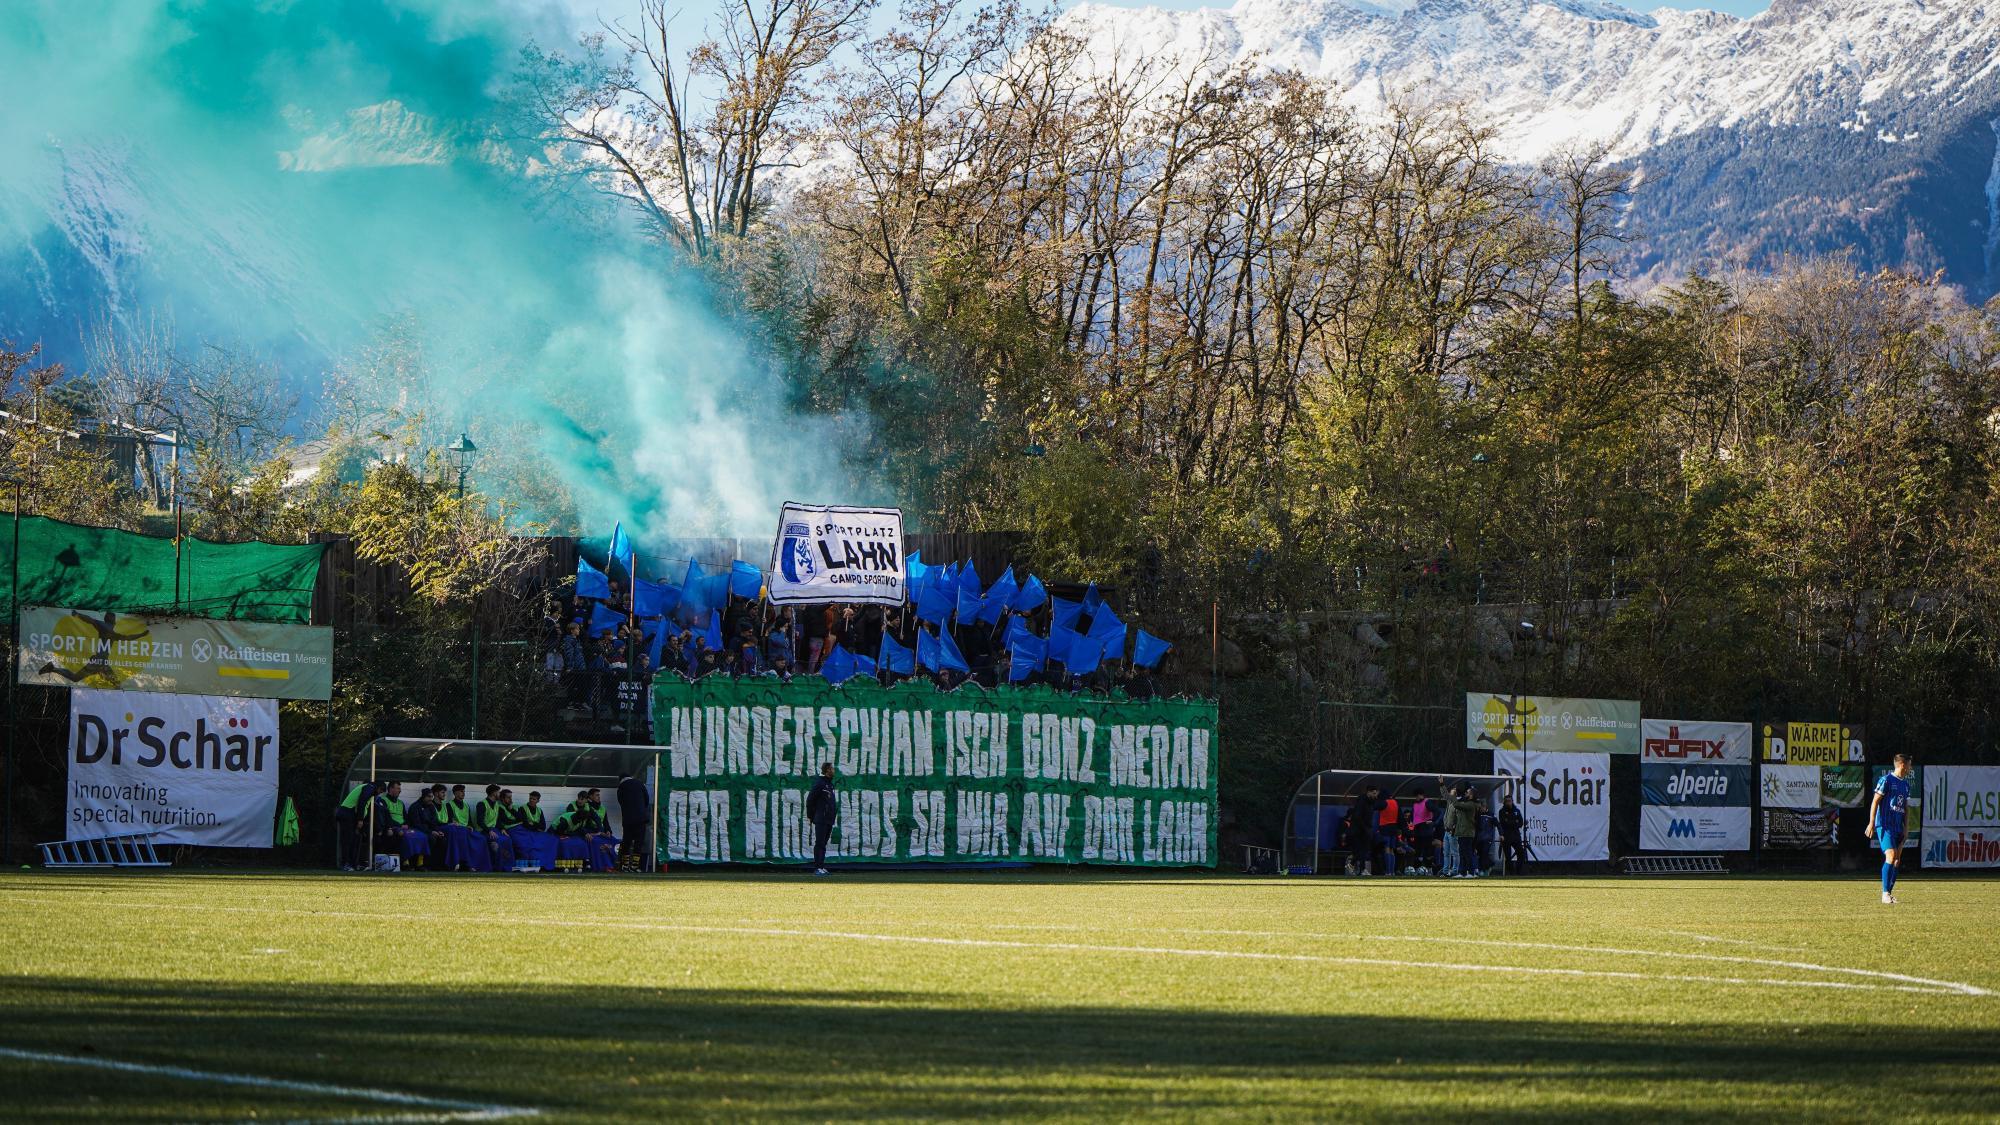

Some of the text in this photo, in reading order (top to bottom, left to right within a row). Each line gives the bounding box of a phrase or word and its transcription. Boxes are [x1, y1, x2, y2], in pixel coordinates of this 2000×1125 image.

[815, 523, 894, 537] SPORTPLATZ
[818, 539, 899, 572] LAHN
[830, 574, 862, 584] CAMPO
[29, 632, 183, 658] SPORT IM HERZEN
[217, 645, 290, 663] Raiffeisen
[1471, 712, 1557, 727] SPORT NEL CUORE
[1575, 715, 1617, 728] Raiffeisen
[1791, 724, 1837, 743] WÄRME
[671, 706, 1209, 790] WUNDERSCHIAN ISCH GONZ MERAN
[1790, 746, 1836, 762] PUMPEN
[74, 780, 168, 805] Innovating
[1529, 766, 1606, 806] Schär
[1667, 768, 1728, 802] alperia
[1827, 780, 1863, 789] Performance
[73, 805, 222, 827] special nutrition.
[909, 790, 946, 857] SO
[1019, 792, 1071, 857] AUF
[1143, 800, 1207, 863] LAHN
[1534, 832, 1579, 846] nutrition.
